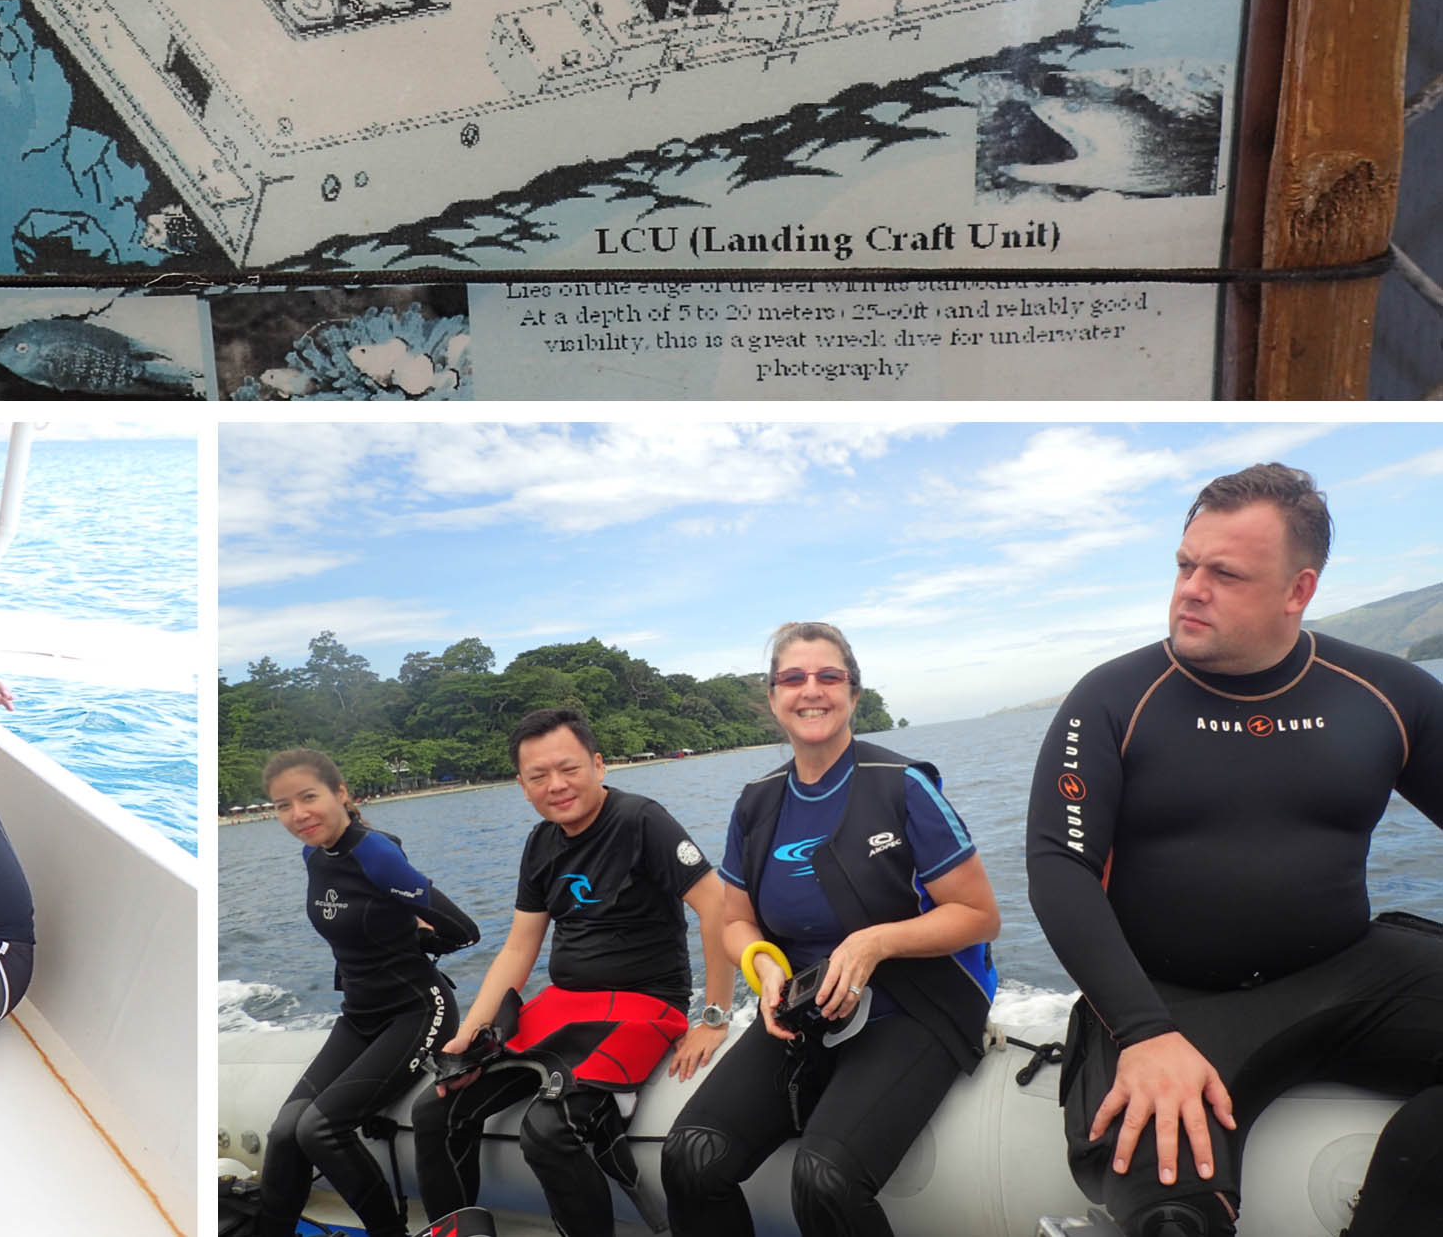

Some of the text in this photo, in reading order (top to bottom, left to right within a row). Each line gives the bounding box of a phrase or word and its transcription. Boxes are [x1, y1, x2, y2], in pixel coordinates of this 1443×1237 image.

[594, 219, 1061, 261] LCU (Landing Craft Unit)
[559, 283, 590, 296] on
[519, 310, 546, 326] At
[555, 311, 569, 325] a
[576, 303, 642, 328] depth
[648, 303, 673, 322] of
[678, 304, 692, 321] 5
[697, 305, 718, 321] to
[725, 304, 752, 321] 20
[757, 306, 835, 321] meters
[945, 300, 989, 319] and
[996, 297, 1084, 321] reliably
[1090, 292, 1148, 319] good
[656, 331, 698, 349] this
[705, 332, 723, 349] is
[730, 334, 744, 348] a
[747, 332, 807, 352] great
[815, 329, 885, 348] wreck
[894, 329, 942, 347] dive
[949, 327, 984, 346] for
[990, 324, 1126, 345] underwater
[755, 358, 910, 381] photography
[1197, 717, 1325, 733] AQUA LUNG
[1063, 718, 1085, 853] AQUA LUNG
[409, 986, 445, 1070] SCUBAPO
